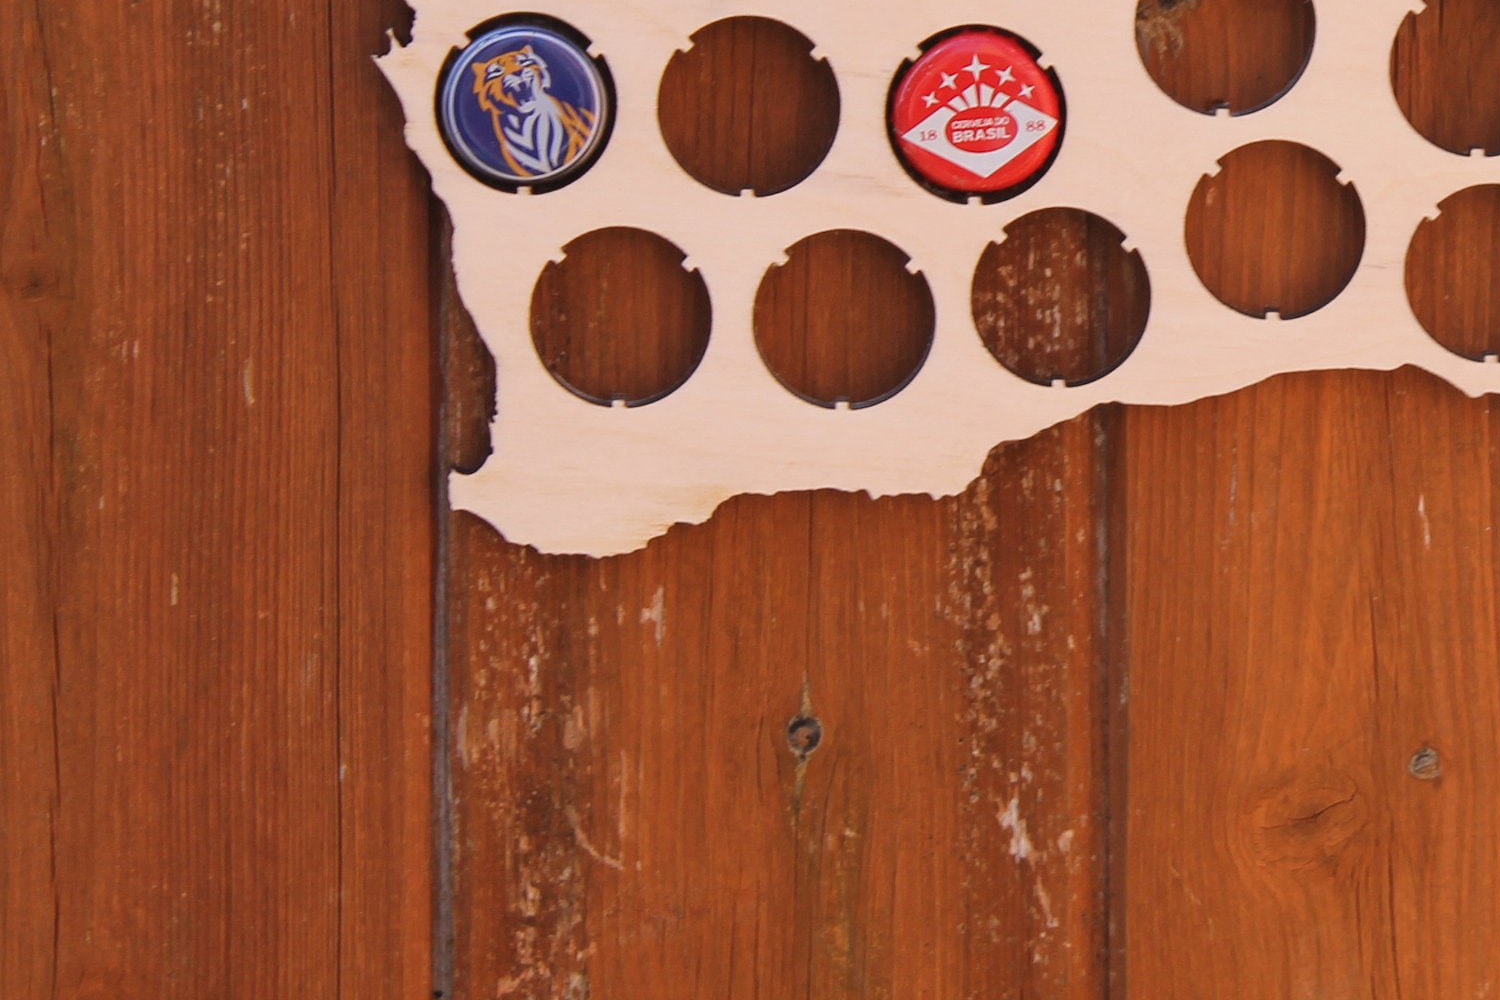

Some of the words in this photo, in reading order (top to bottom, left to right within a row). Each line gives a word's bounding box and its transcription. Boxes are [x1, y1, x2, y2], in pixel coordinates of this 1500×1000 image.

[1025, 119, 1047, 132] 88
[919, 129, 938, 142] 18
[951, 127, 1012, 144] BRASIL
